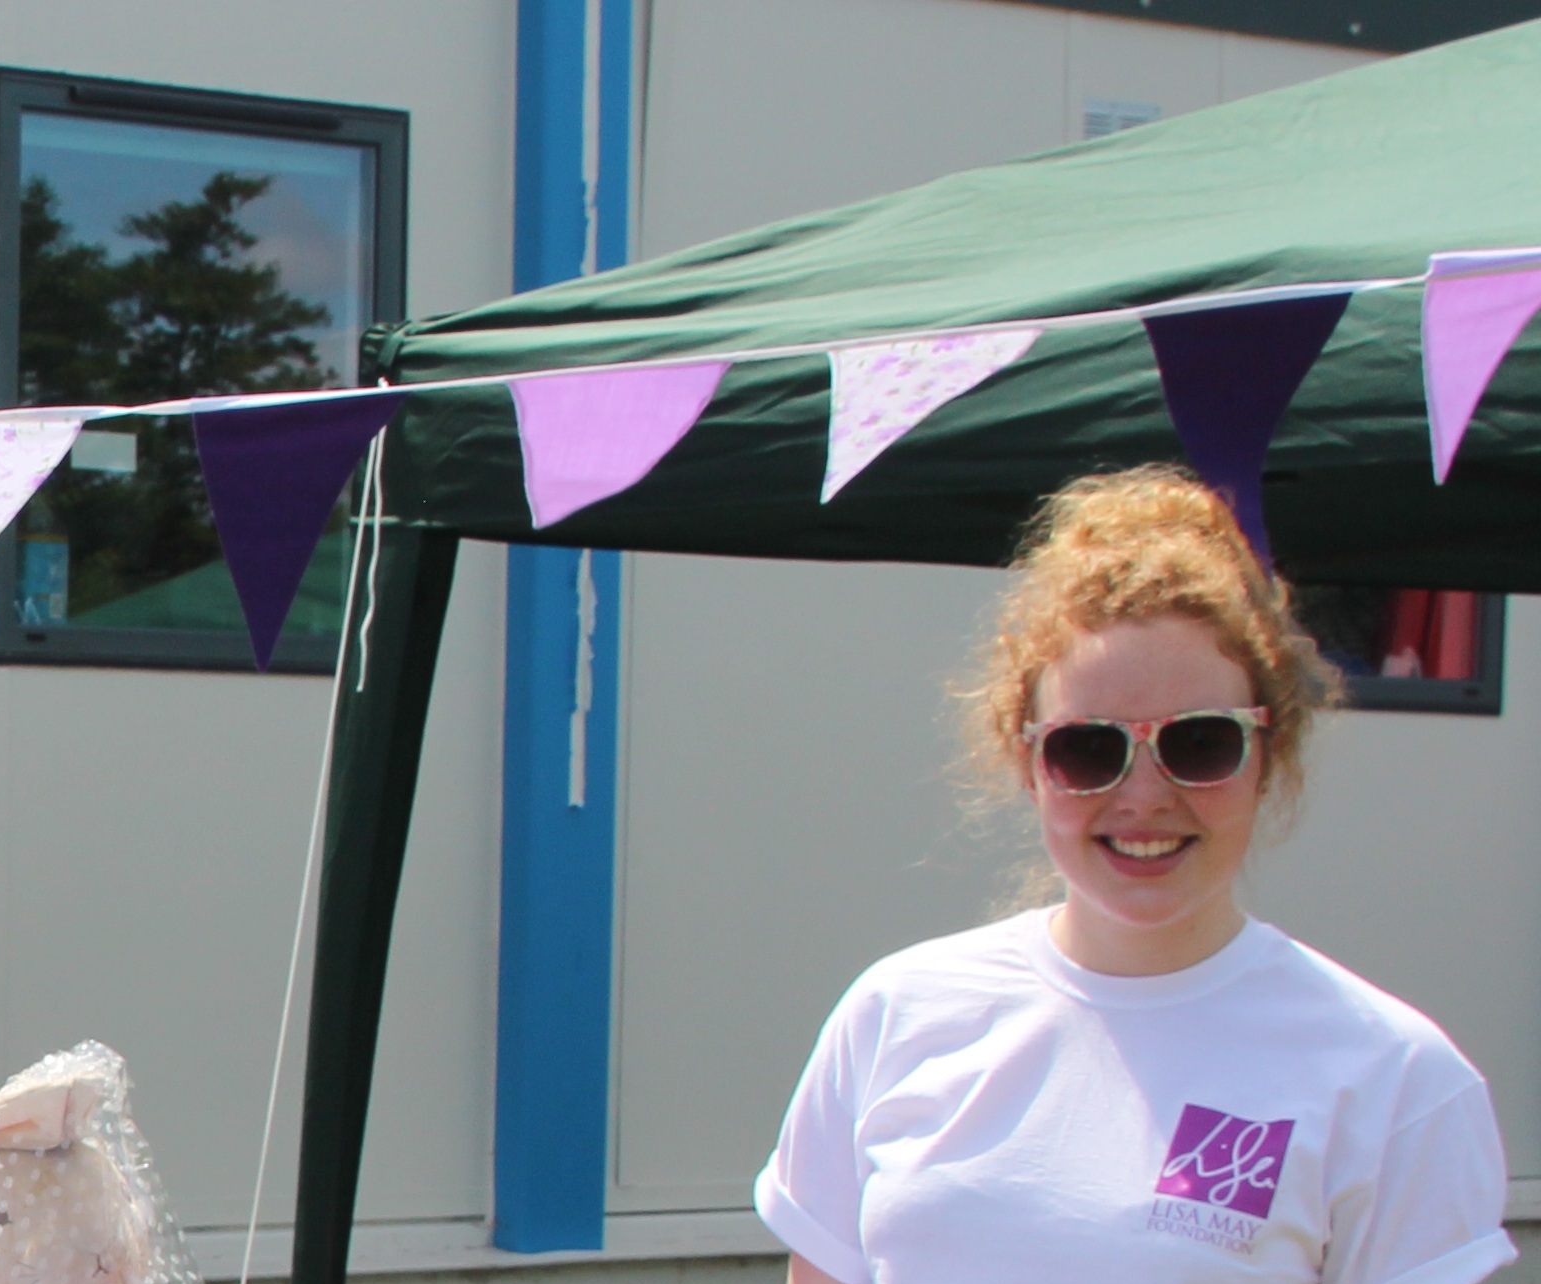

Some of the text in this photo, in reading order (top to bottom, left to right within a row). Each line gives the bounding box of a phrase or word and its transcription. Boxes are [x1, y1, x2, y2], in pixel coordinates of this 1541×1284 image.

[1147, 1218, 1252, 1254] FOUNDATION
[1152, 1199, 1262, 1241] LISA MAY
